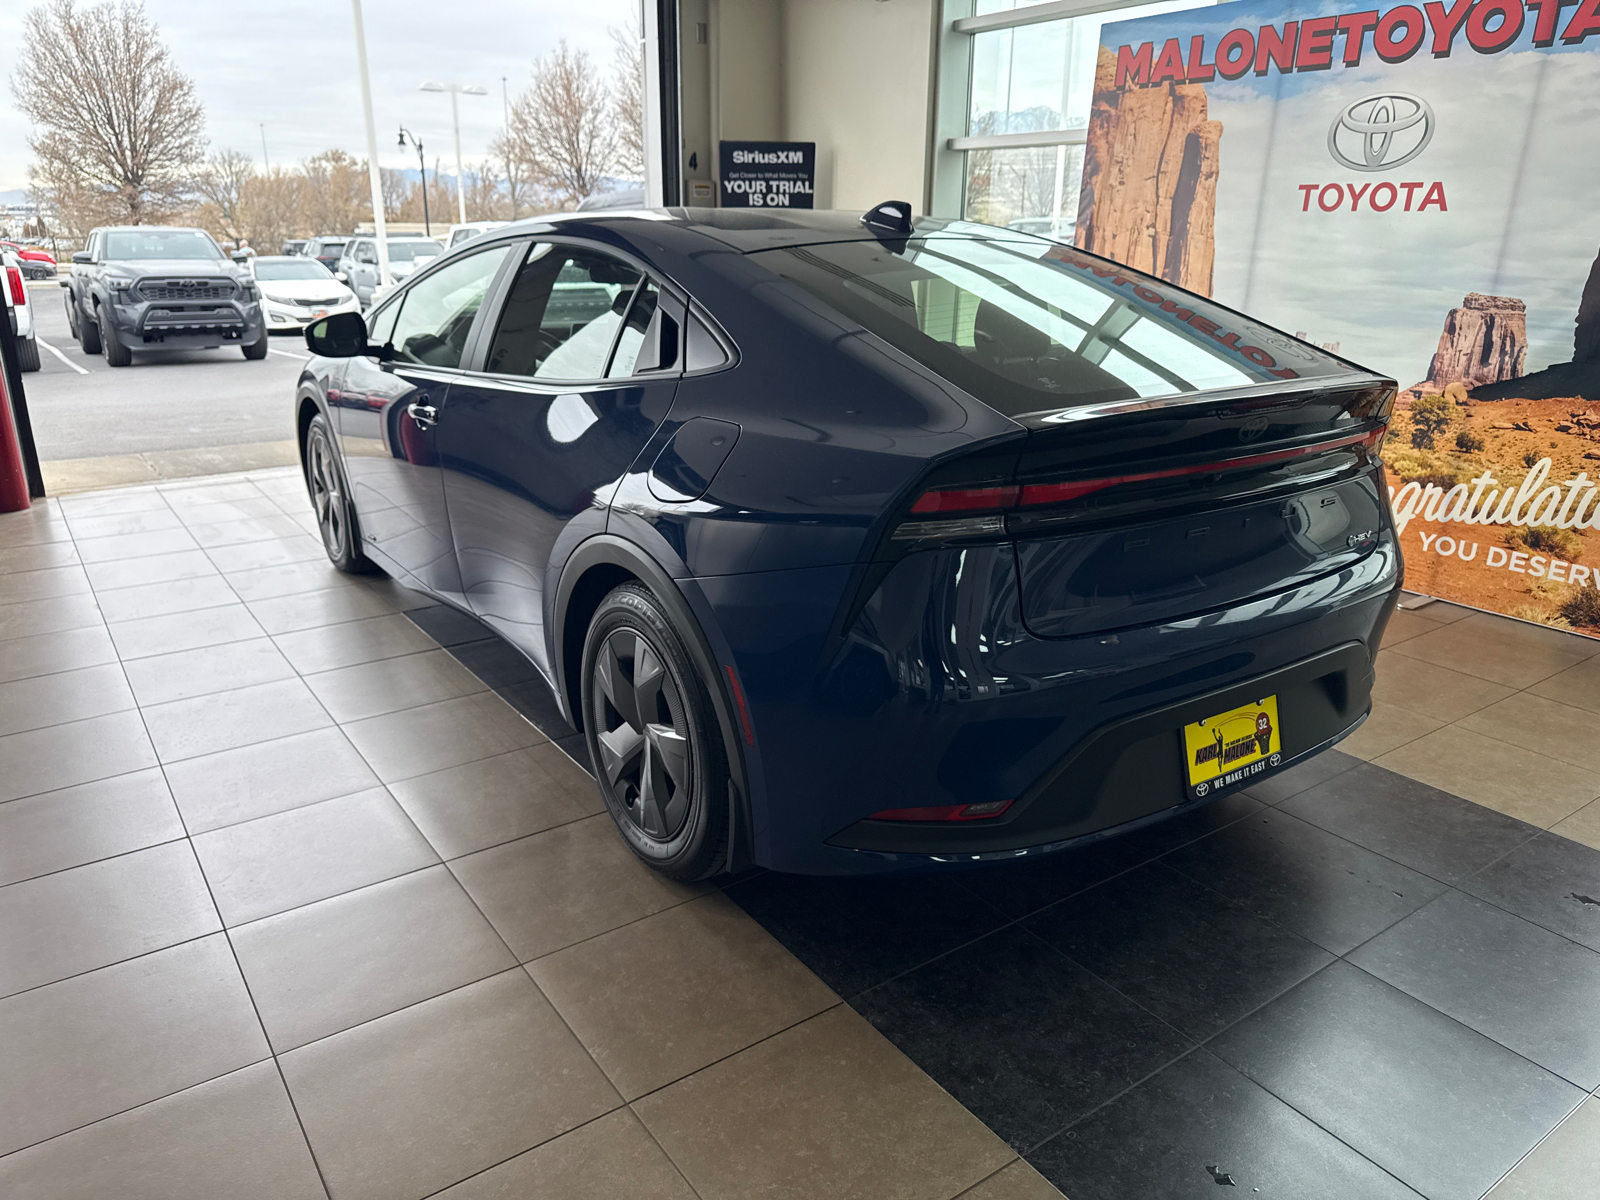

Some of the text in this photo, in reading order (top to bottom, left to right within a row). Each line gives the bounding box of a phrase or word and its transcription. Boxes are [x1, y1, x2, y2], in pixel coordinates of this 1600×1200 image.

[689, 152, 698, 171] 4
[732, 150, 803, 164] SiriusXM
[798, 172, 808, 180] You
[724, 181, 766, 193] YOUR
[769, 181, 813, 194] TRIAL
[748, 193, 790, 206] IS ON
[1298, 181, 1448, 212] TOYOTA
[1388, 457, 1600, 537] gratulati
[1353, 530, 1372, 543] HEV
[1419, 531, 1478, 561] YOU
[1258, 718, 1267, 730] 32
[1195, 742, 1218, 766] KARL
[1223, 739, 1256, 765] MALONE
[1213, 762, 1266, 789] WE MAKE IT EASY
